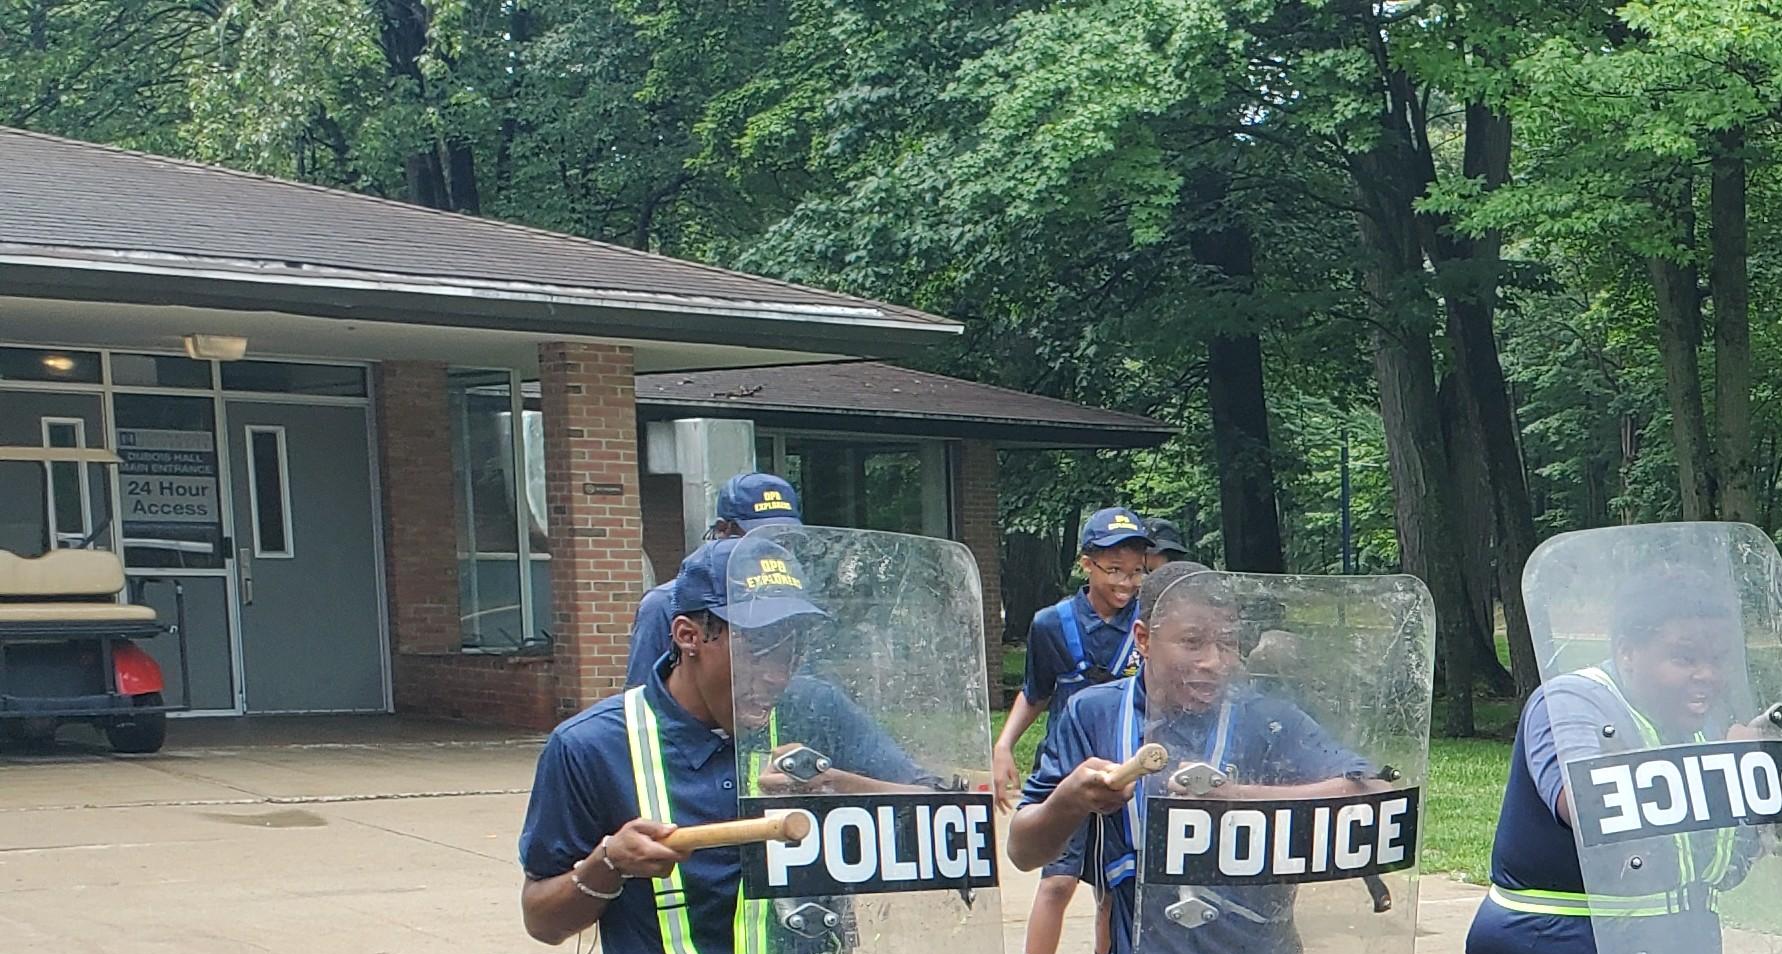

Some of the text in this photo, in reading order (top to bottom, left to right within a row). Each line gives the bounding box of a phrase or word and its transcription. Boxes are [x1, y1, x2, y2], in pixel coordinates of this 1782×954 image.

[174, 453, 203, 463] HALL
[151, 462, 213, 474] ENTRANCE
[127, 481, 210, 497] 24 Hour
[132, 500, 209, 516] Access
[1166, 797, 1408, 877] POLICE
[763, 804, 992, 888] POLICE
